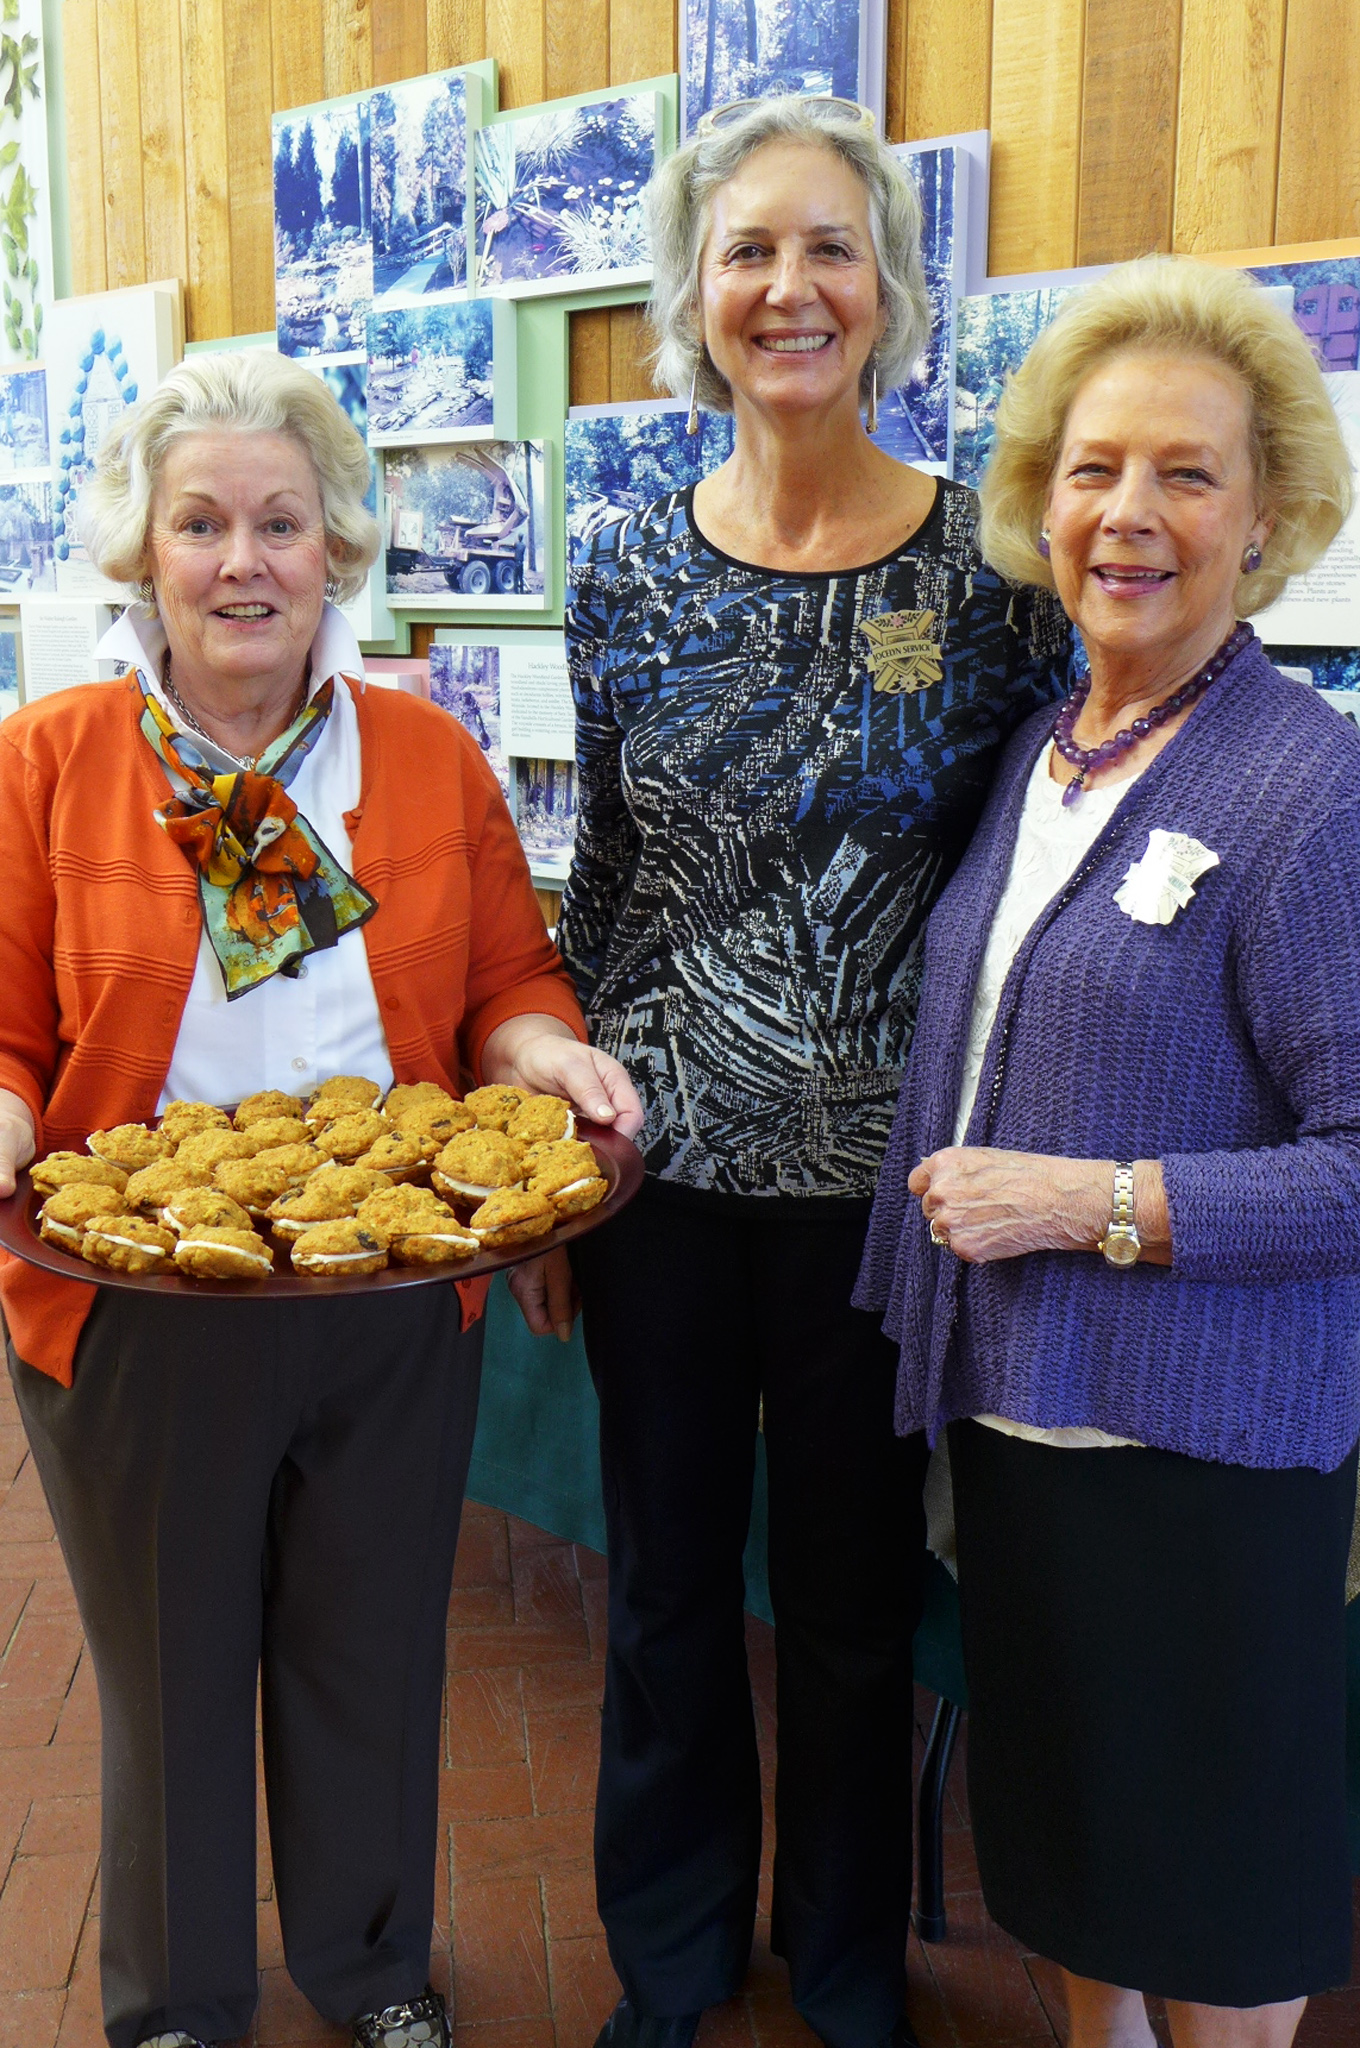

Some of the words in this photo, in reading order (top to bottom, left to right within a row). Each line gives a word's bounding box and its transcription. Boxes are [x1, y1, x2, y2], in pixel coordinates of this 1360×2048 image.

[872, 647, 902, 663] JOCELYN
[528, 662, 549, 671] Hackley
[549, 662, 568, 670] Woodl
